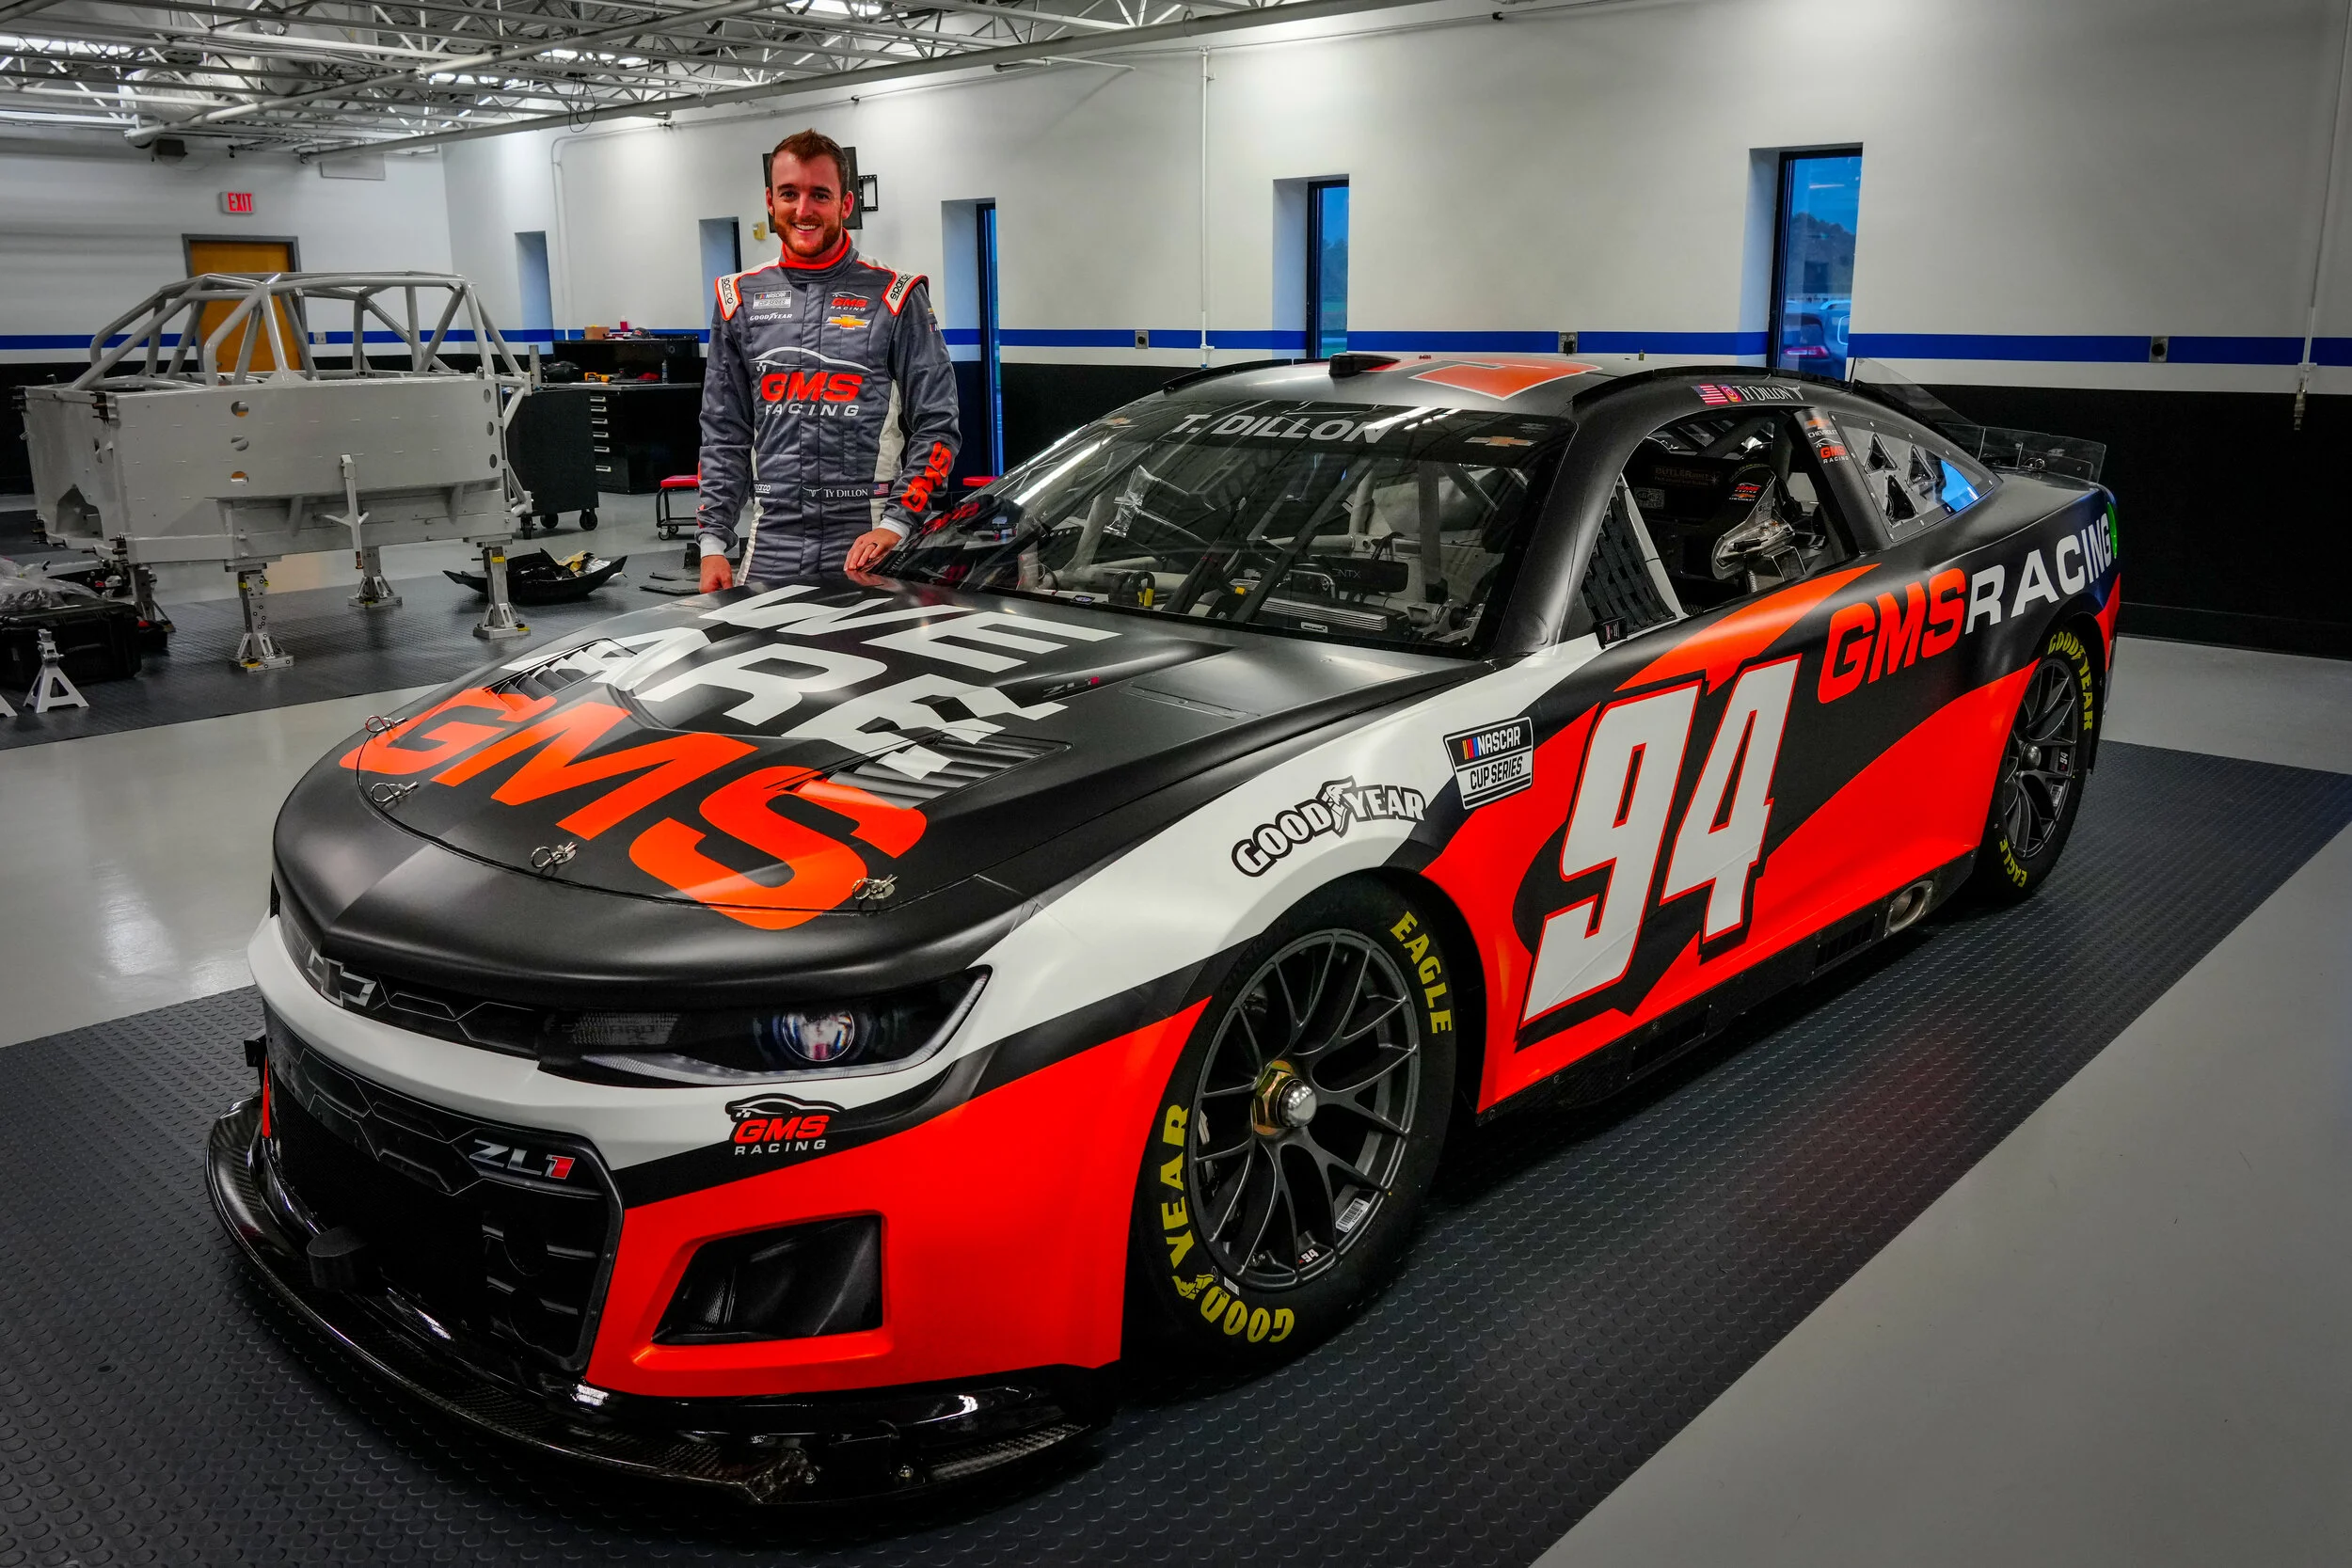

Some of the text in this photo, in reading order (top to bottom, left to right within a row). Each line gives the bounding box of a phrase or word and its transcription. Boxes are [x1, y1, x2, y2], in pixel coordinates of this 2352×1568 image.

[228, 193, 253, 212] EXIT
[832, 298, 867, 308] GMS
[761, 372, 863, 402] GMS
[1748, 386, 1793, 401] DILLON
[1172, 414, 1397, 444] T. DILLON
[1820, 445, 1846, 458] GMS
[1822, 455, 1849, 464] RACING
[901, 441, 952, 513] GMS
[836, 488, 868, 498] DILLON
[699, 584, 1122, 673] WE
[501, 627, 1069, 780] ARE
[1476, 726, 1521, 755] NASCAR
[1470, 756, 1523, 790] CUP SERIES
[339, 687, 927, 929] GMS
[1521, 657, 1800, 1024] 94
[1999, 836, 2027, 887] EAGLE
[1391, 911, 1452, 1034] EAGLE
[734, 1115, 830, 1143] GMS
[469, 1138, 576, 1180] ZL1
[735, 1139, 827, 1156] RACING
[1301, 1248, 1319, 1263] 94
